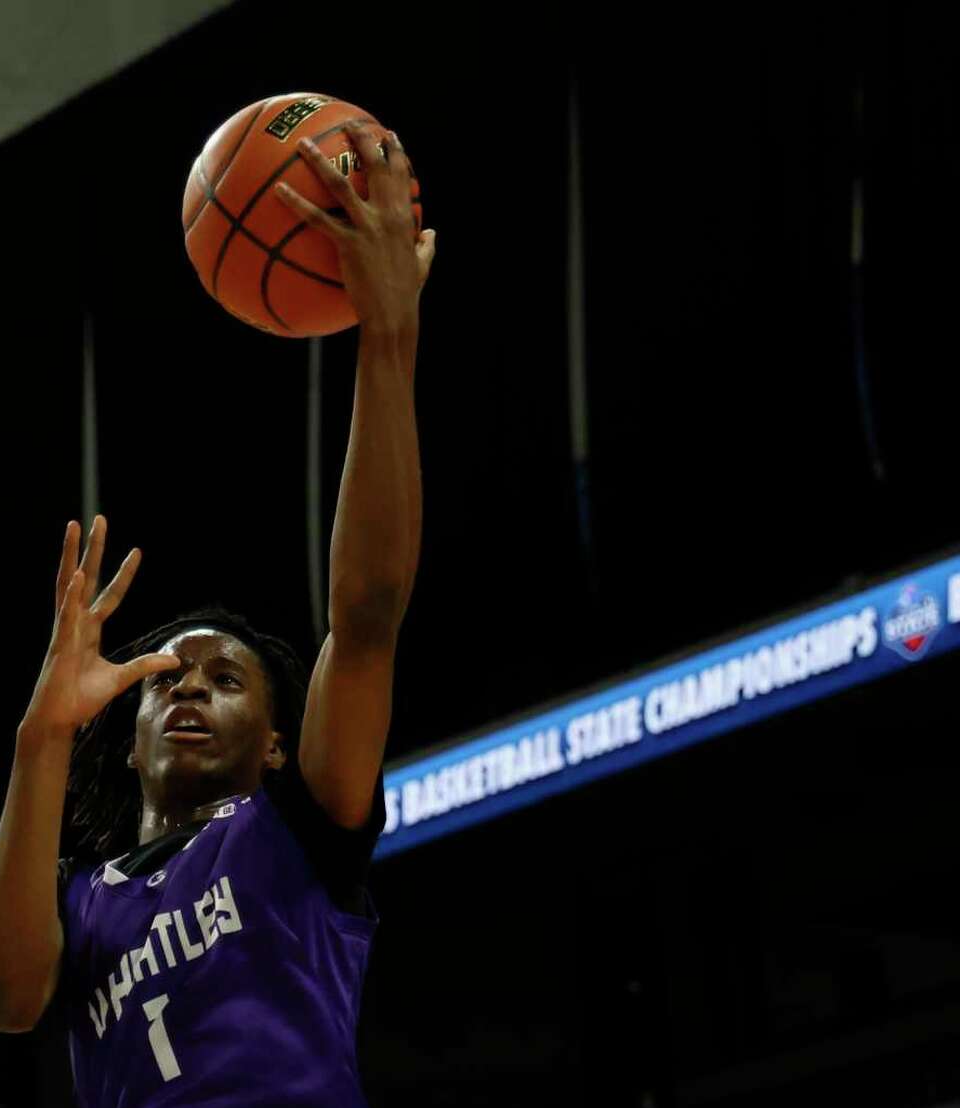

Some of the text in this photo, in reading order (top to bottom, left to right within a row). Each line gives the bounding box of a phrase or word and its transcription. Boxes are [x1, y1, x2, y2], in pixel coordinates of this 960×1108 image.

[401, 728, 565, 827] BASKETBALL
[566, 696, 643, 766] STATE
[644, 606, 878, 734] CHAMPIONSHIPS
[142, 993, 182, 1083] 1
